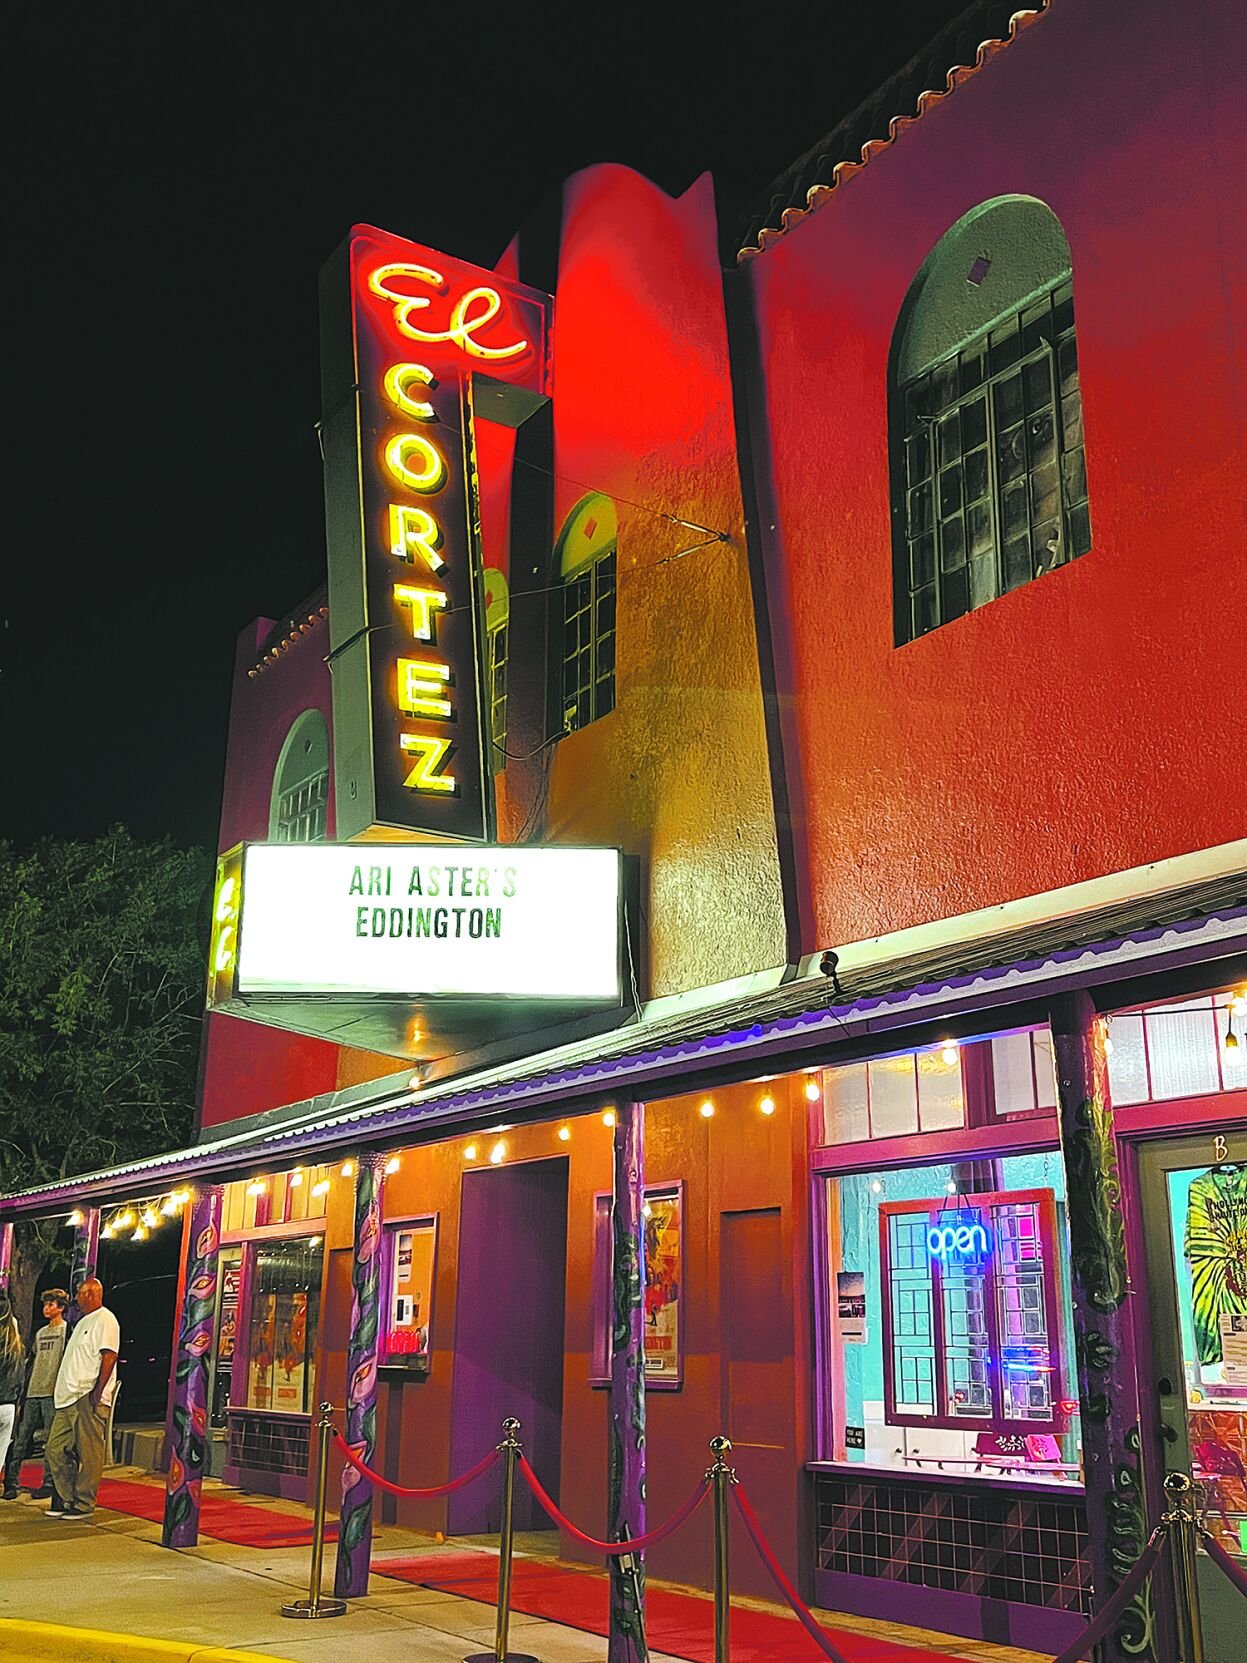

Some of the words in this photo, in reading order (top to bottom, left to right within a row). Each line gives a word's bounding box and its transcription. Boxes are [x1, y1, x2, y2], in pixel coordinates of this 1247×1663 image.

[367, 262, 528, 360] El
[383, 362, 456, 797] CORTEZ
[348, 864, 392, 897] ARI
[407, 864, 518, 898] ASTER'S
[355, 906, 502, 939] EDDINGTON
[1212, 1134, 1228, 1162] B
[927, 1225, 988, 1260] open
